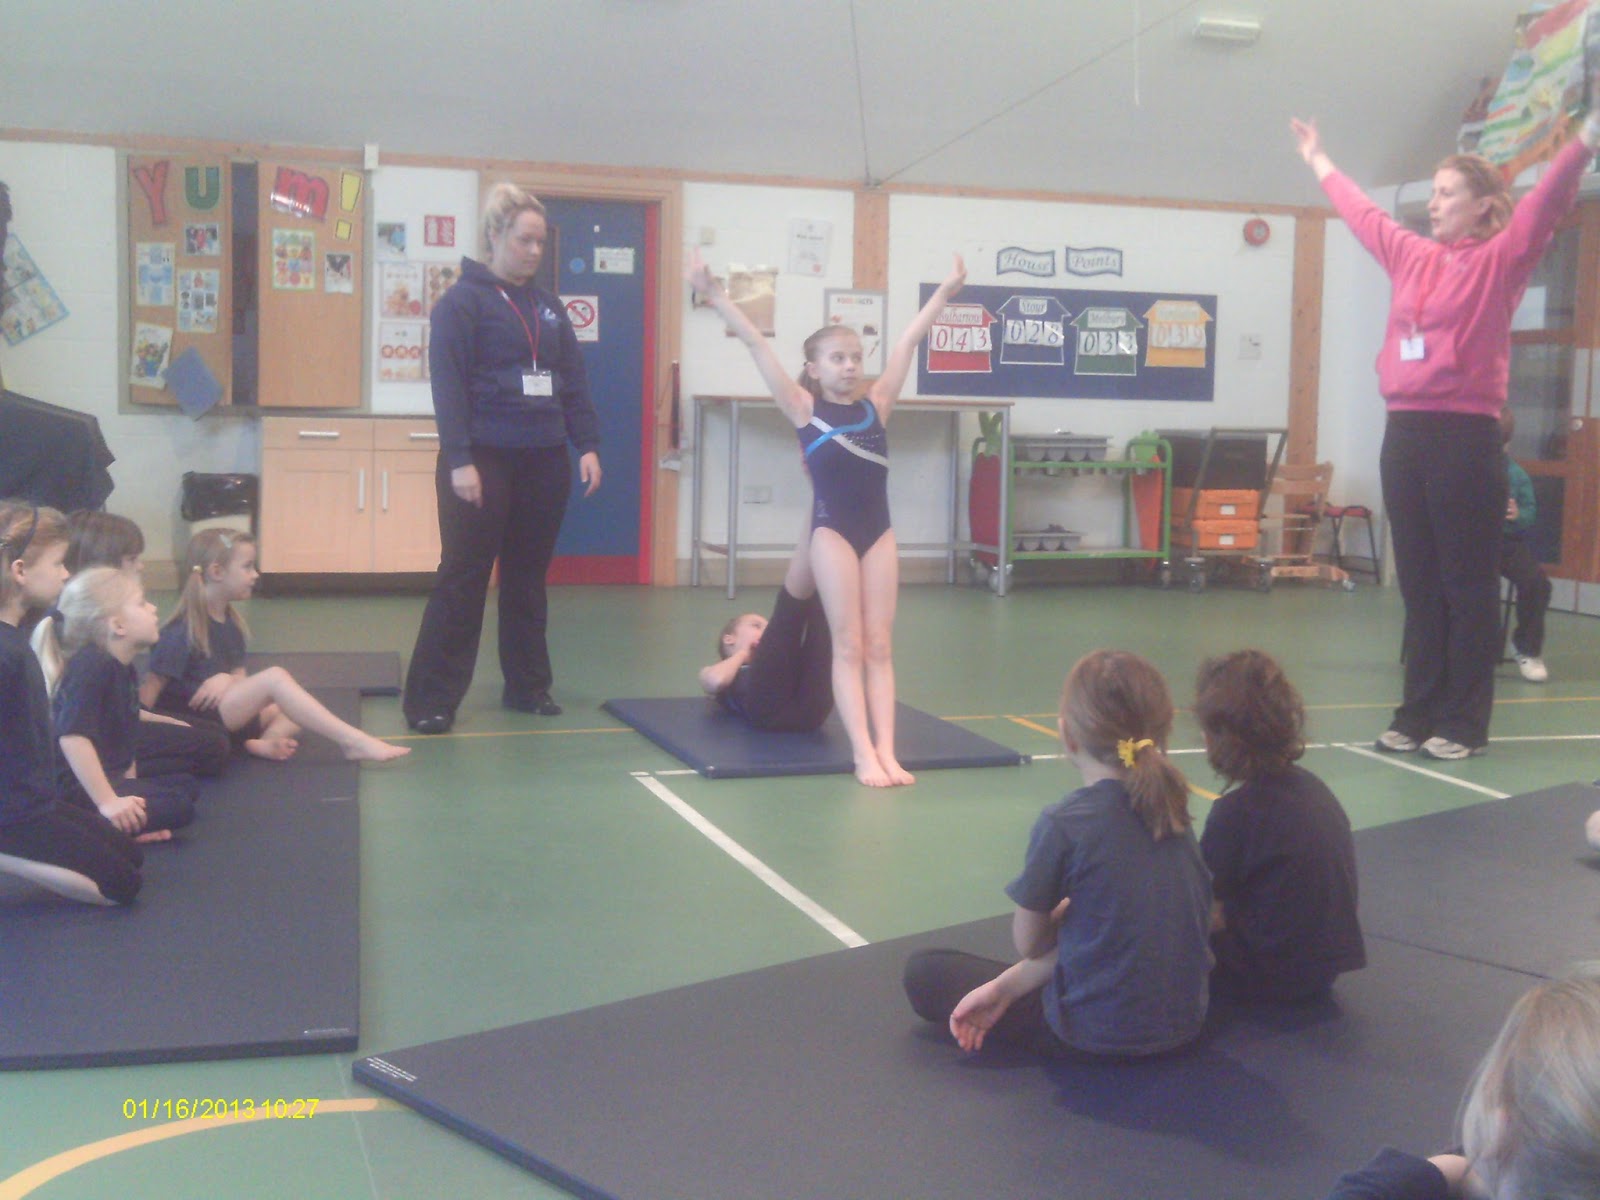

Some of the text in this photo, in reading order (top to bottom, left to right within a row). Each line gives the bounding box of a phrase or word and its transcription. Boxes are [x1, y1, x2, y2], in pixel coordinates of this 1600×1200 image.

[1003, 252, 1118, 272] House Points
[936, 328, 988, 351] 043
[1011, 320, 1059, 344] 028
